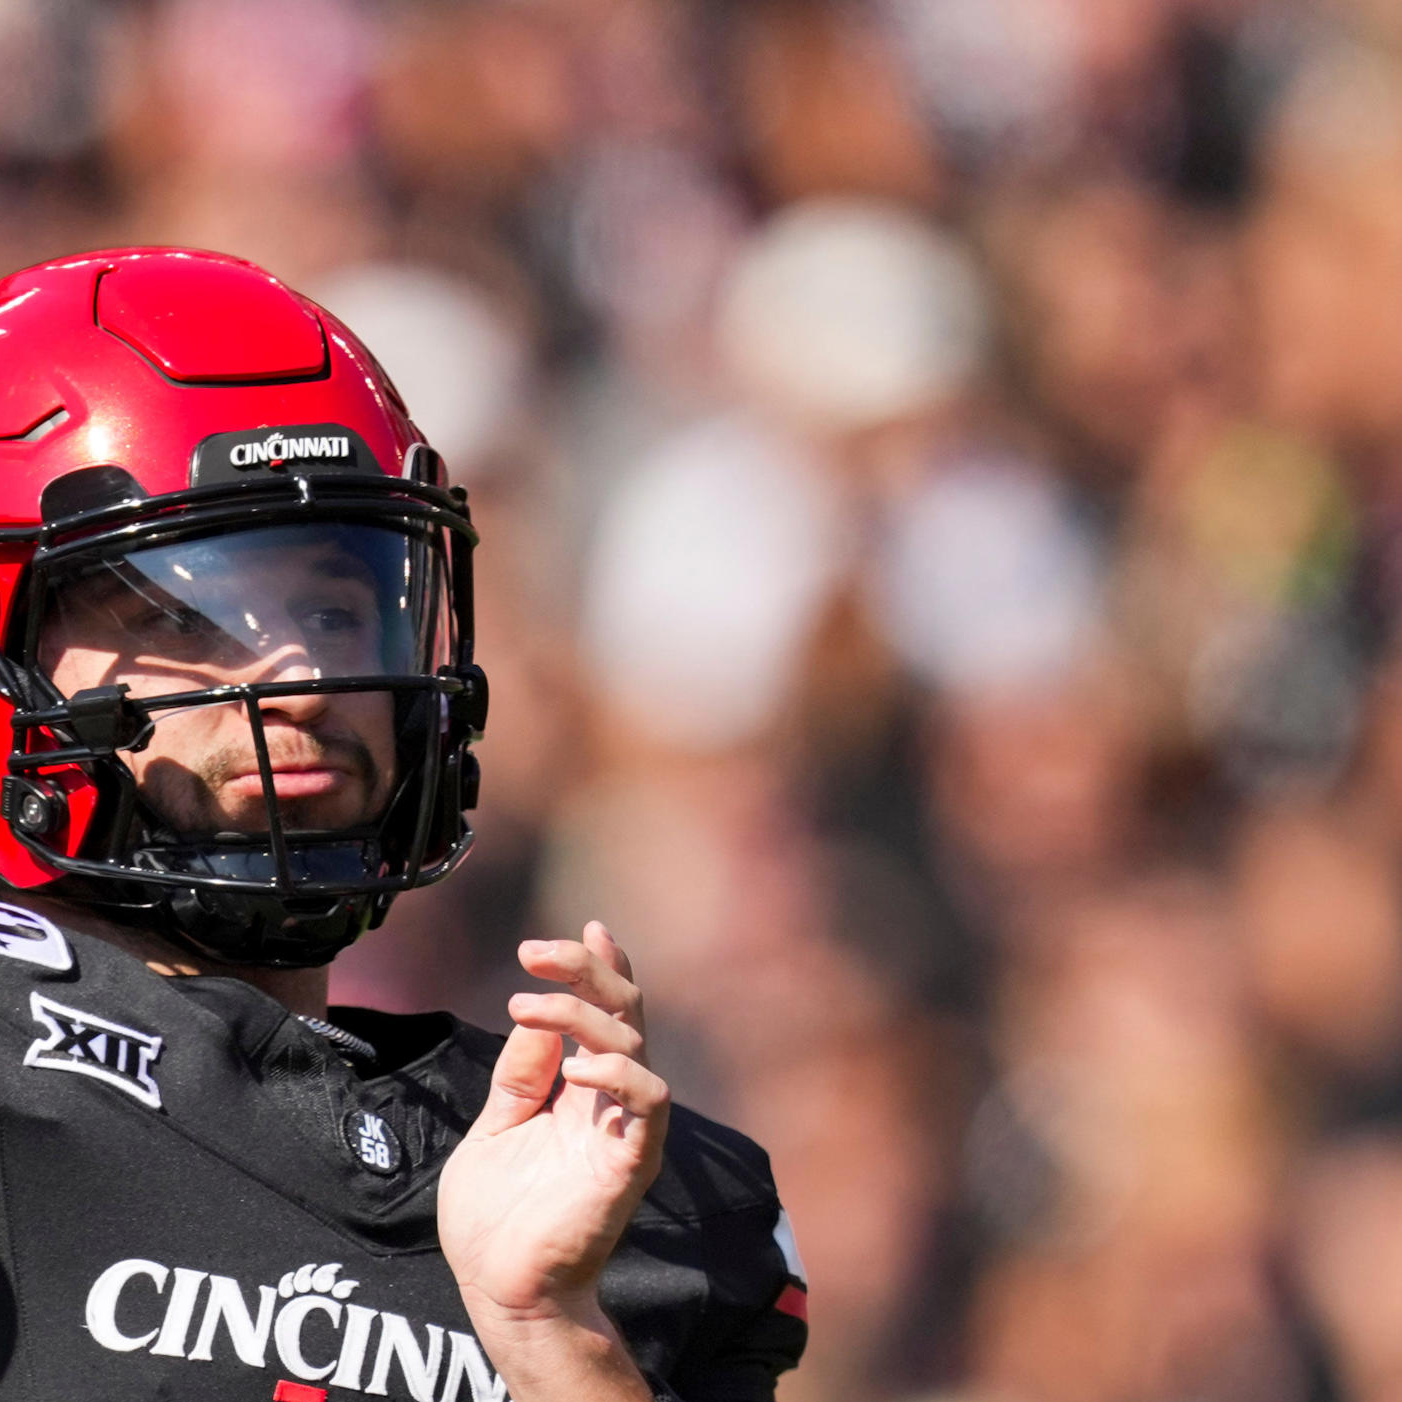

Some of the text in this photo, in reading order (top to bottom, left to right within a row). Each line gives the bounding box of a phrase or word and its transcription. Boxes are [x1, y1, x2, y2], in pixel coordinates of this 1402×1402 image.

[229, 431, 350, 468] CINCINNATI
[36, 1003, 156, 1095] XII
[358, 1113, 387, 1143] JK
[360, 1137, 390, 1169] 58
